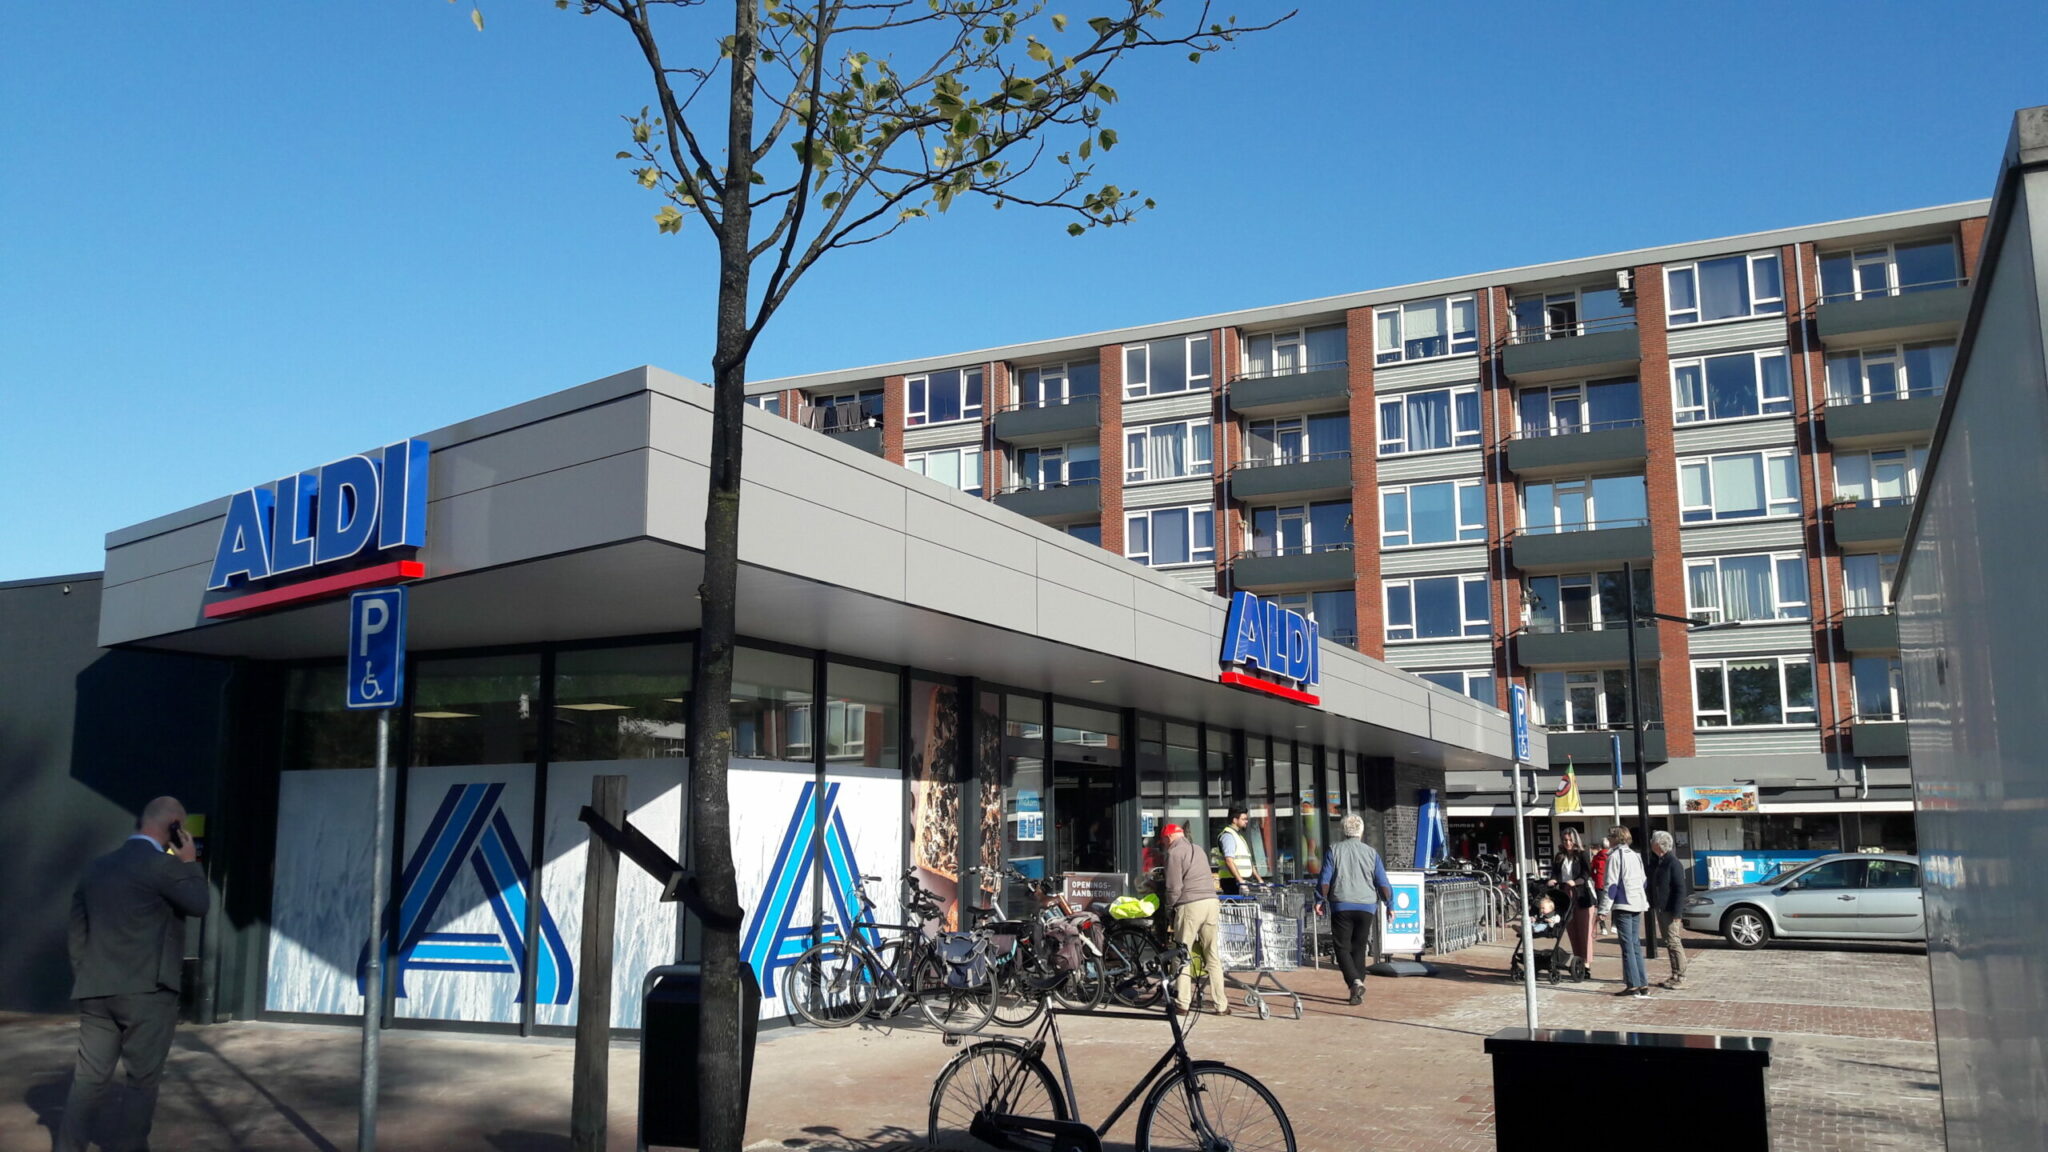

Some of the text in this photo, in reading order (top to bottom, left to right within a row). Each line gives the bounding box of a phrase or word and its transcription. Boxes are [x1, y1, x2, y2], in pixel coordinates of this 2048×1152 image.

[206, 438, 412, 590] ALDI
[360, 599, 389, 656] P
[1232, 591, 1320, 687] ALDI
[1516, 691, 1525, 728] P
[1071, 881, 1112, 889] OPENINGS-
[1071, 889, 1117, 898] AANBIEDING
